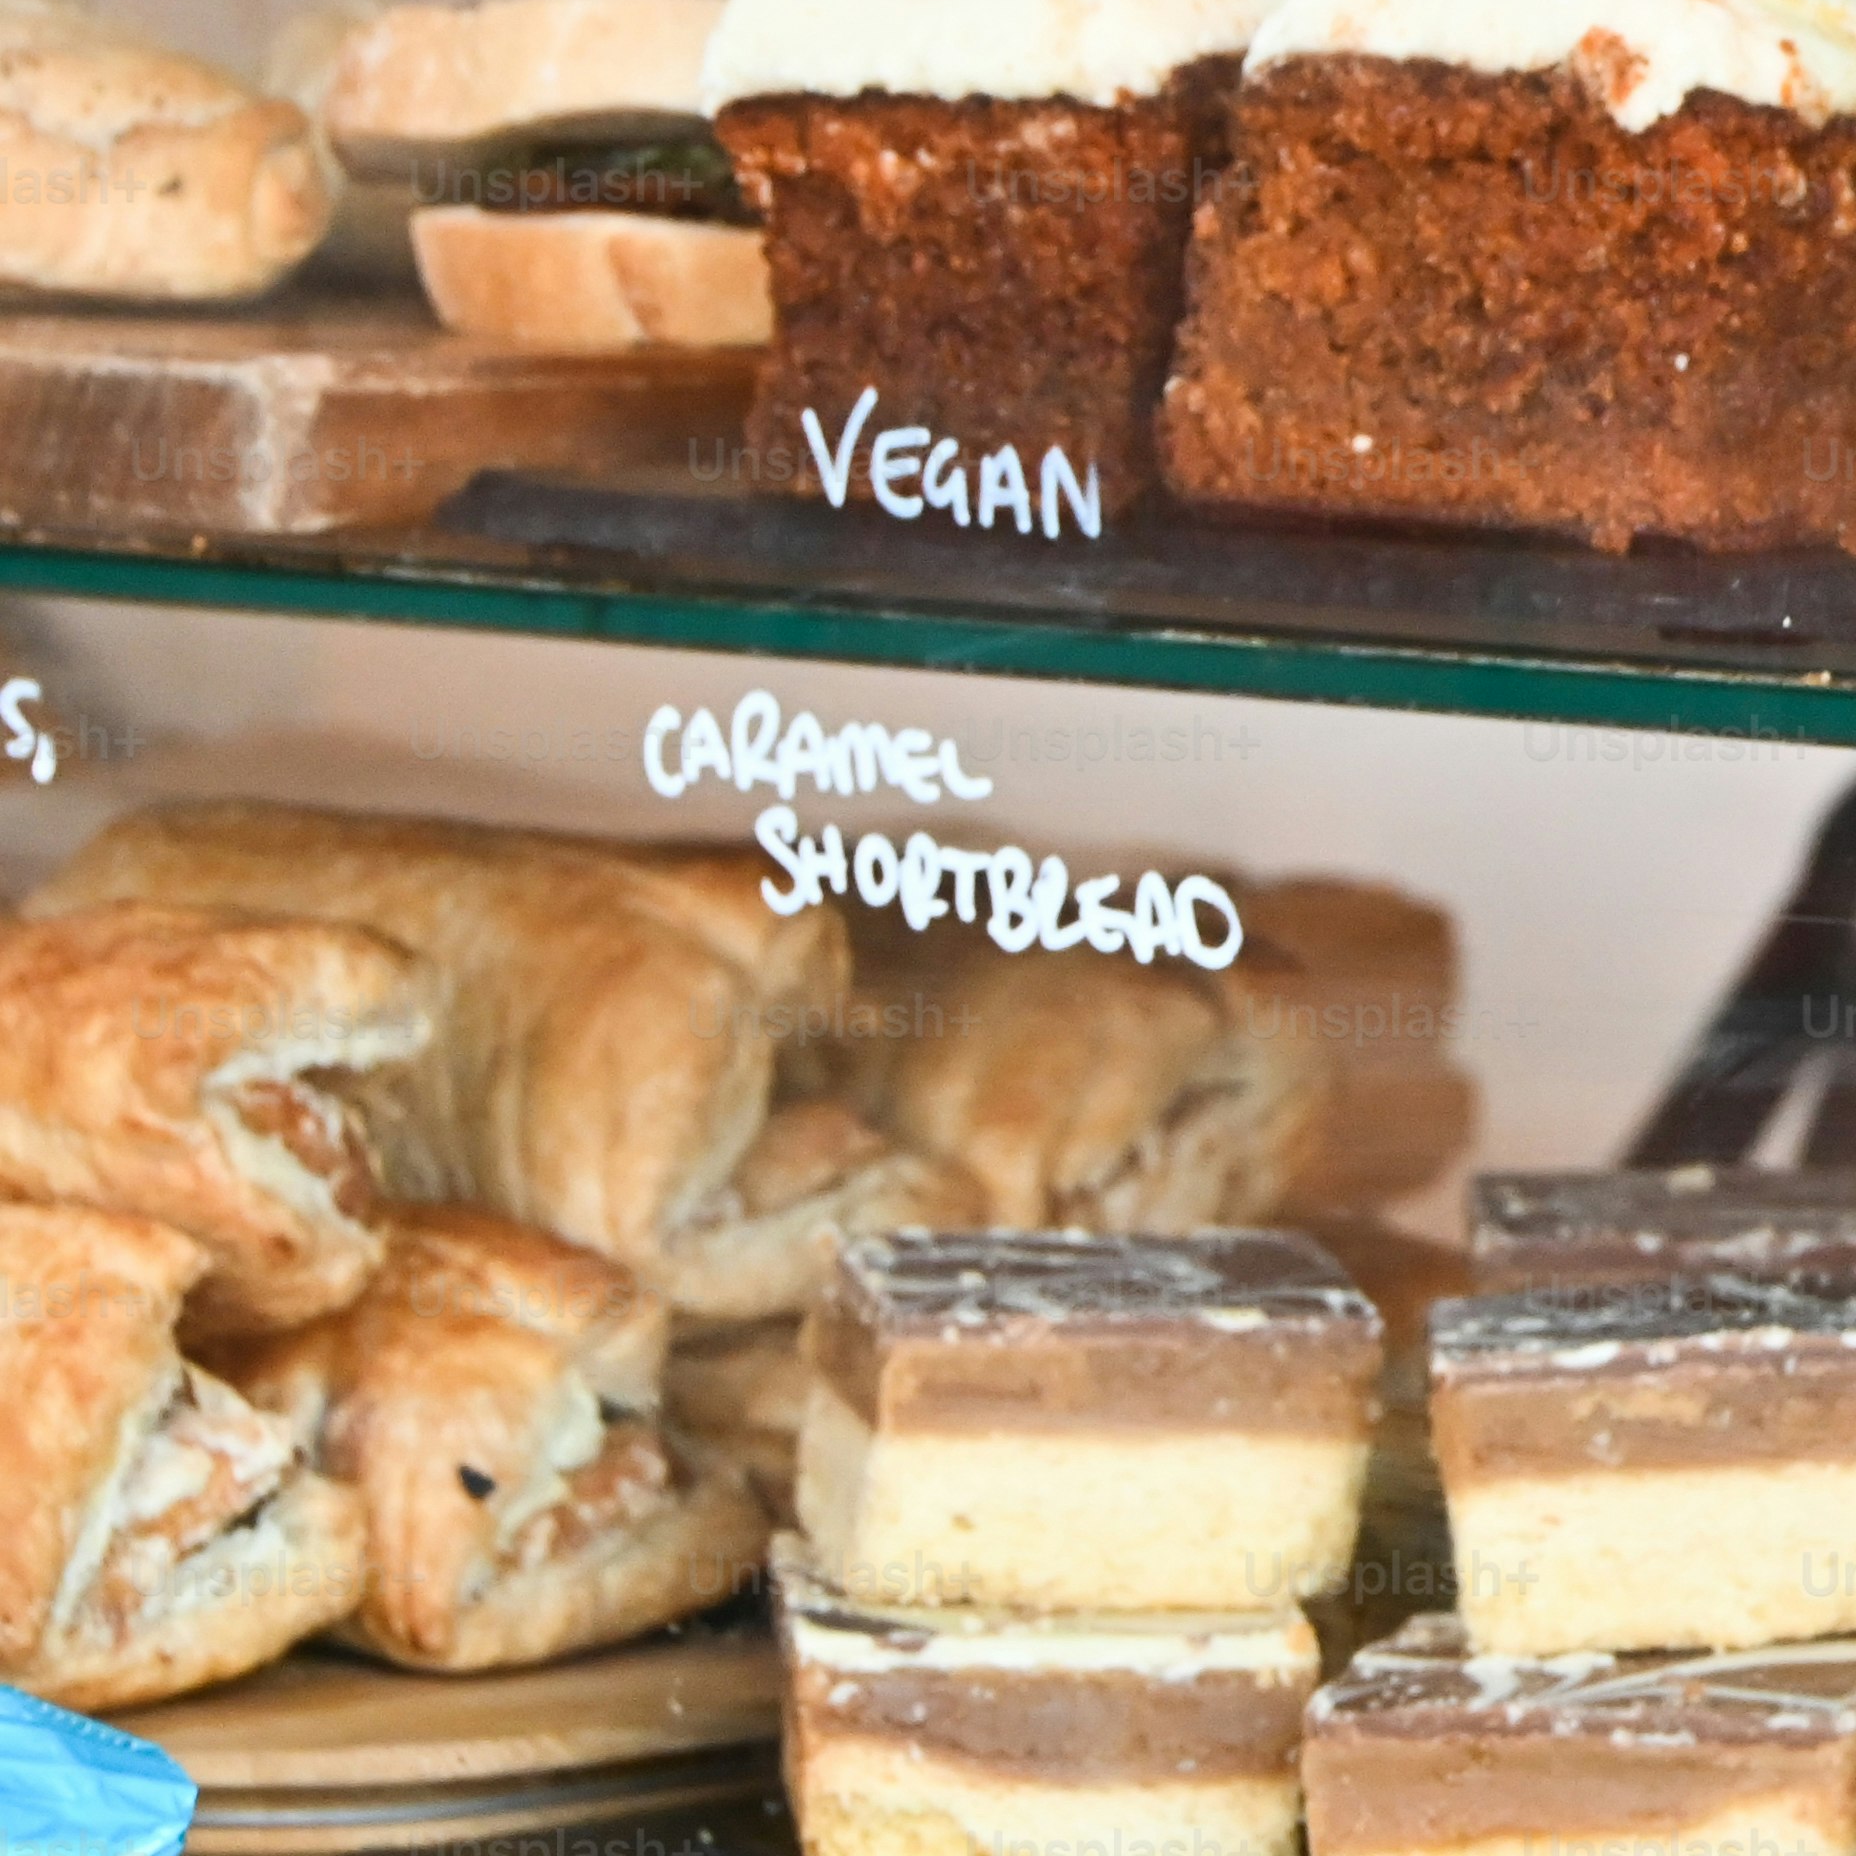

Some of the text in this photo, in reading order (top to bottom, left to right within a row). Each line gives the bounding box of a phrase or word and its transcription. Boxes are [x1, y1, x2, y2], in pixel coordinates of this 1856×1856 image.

[801, 388, 1101, 541] VEGAN
[644, 689, 993, 804] CARAMEL
[755, 806, 1243, 971] SHORTBREAD
